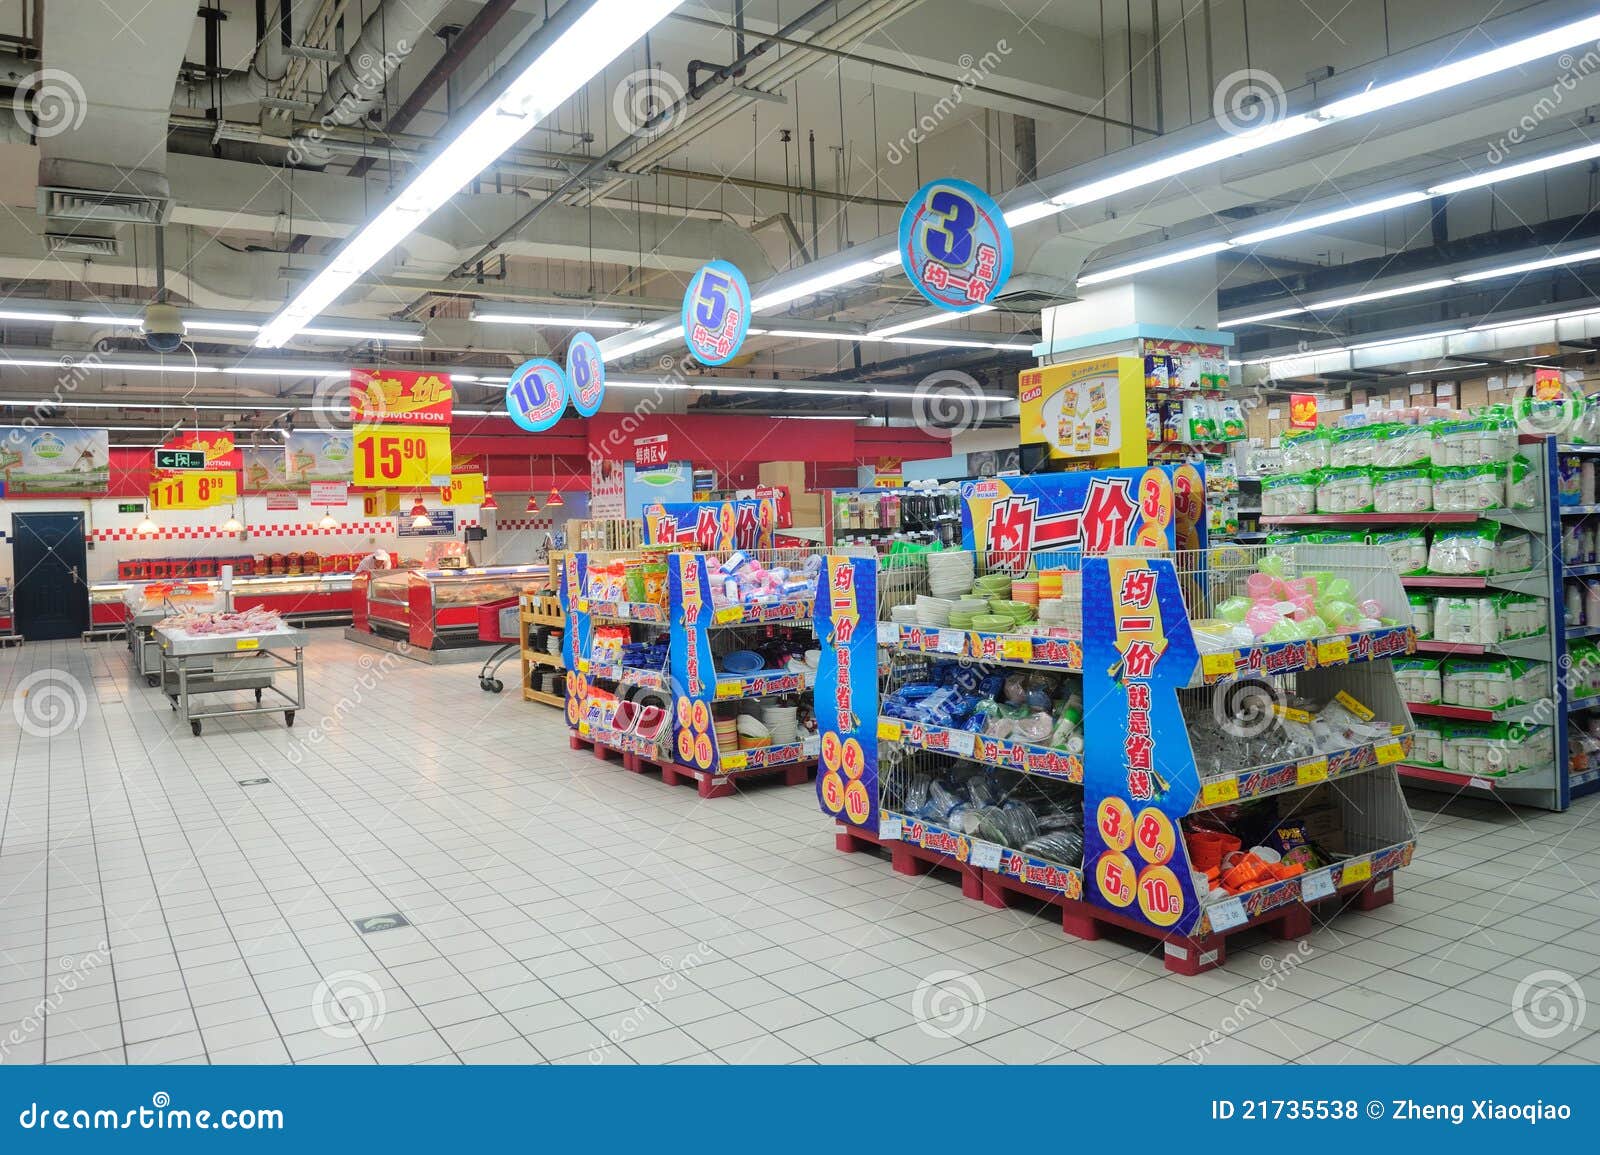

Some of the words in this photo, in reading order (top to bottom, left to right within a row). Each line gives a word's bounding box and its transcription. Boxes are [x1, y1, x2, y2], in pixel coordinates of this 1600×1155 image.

[925, 188, 978, 267] 3
[923, 261, 989, 303] 均一价
[695, 271, 729, 329] 5
[572, 345, 590, 387] 8
[510, 374, 547, 414] 10
[1022, 387, 1041, 402] GLAD
[1143, 478, 1161, 518] 3
[1175, 475, 1191, 514] 3
[723, 510, 730, 533] 3
[987, 482, 1133, 577] 均一价
[834, 564, 854, 642] 均一价
[1121, 570, 1157, 677] 均一价
[682, 738, 689, 757] 5
[697, 742, 708, 761] 10
[825, 738, 835, 761] 3
[844, 744, 856, 769] 8
[827, 781, 837, 804] 5
[848, 790, 862, 815] 10
[1102, 805, 1121, 838] 3
[1139, 814, 1161, 849] 8
[1104, 862, 1122, 895] 5
[1143, 879, 1170, 914] 10
